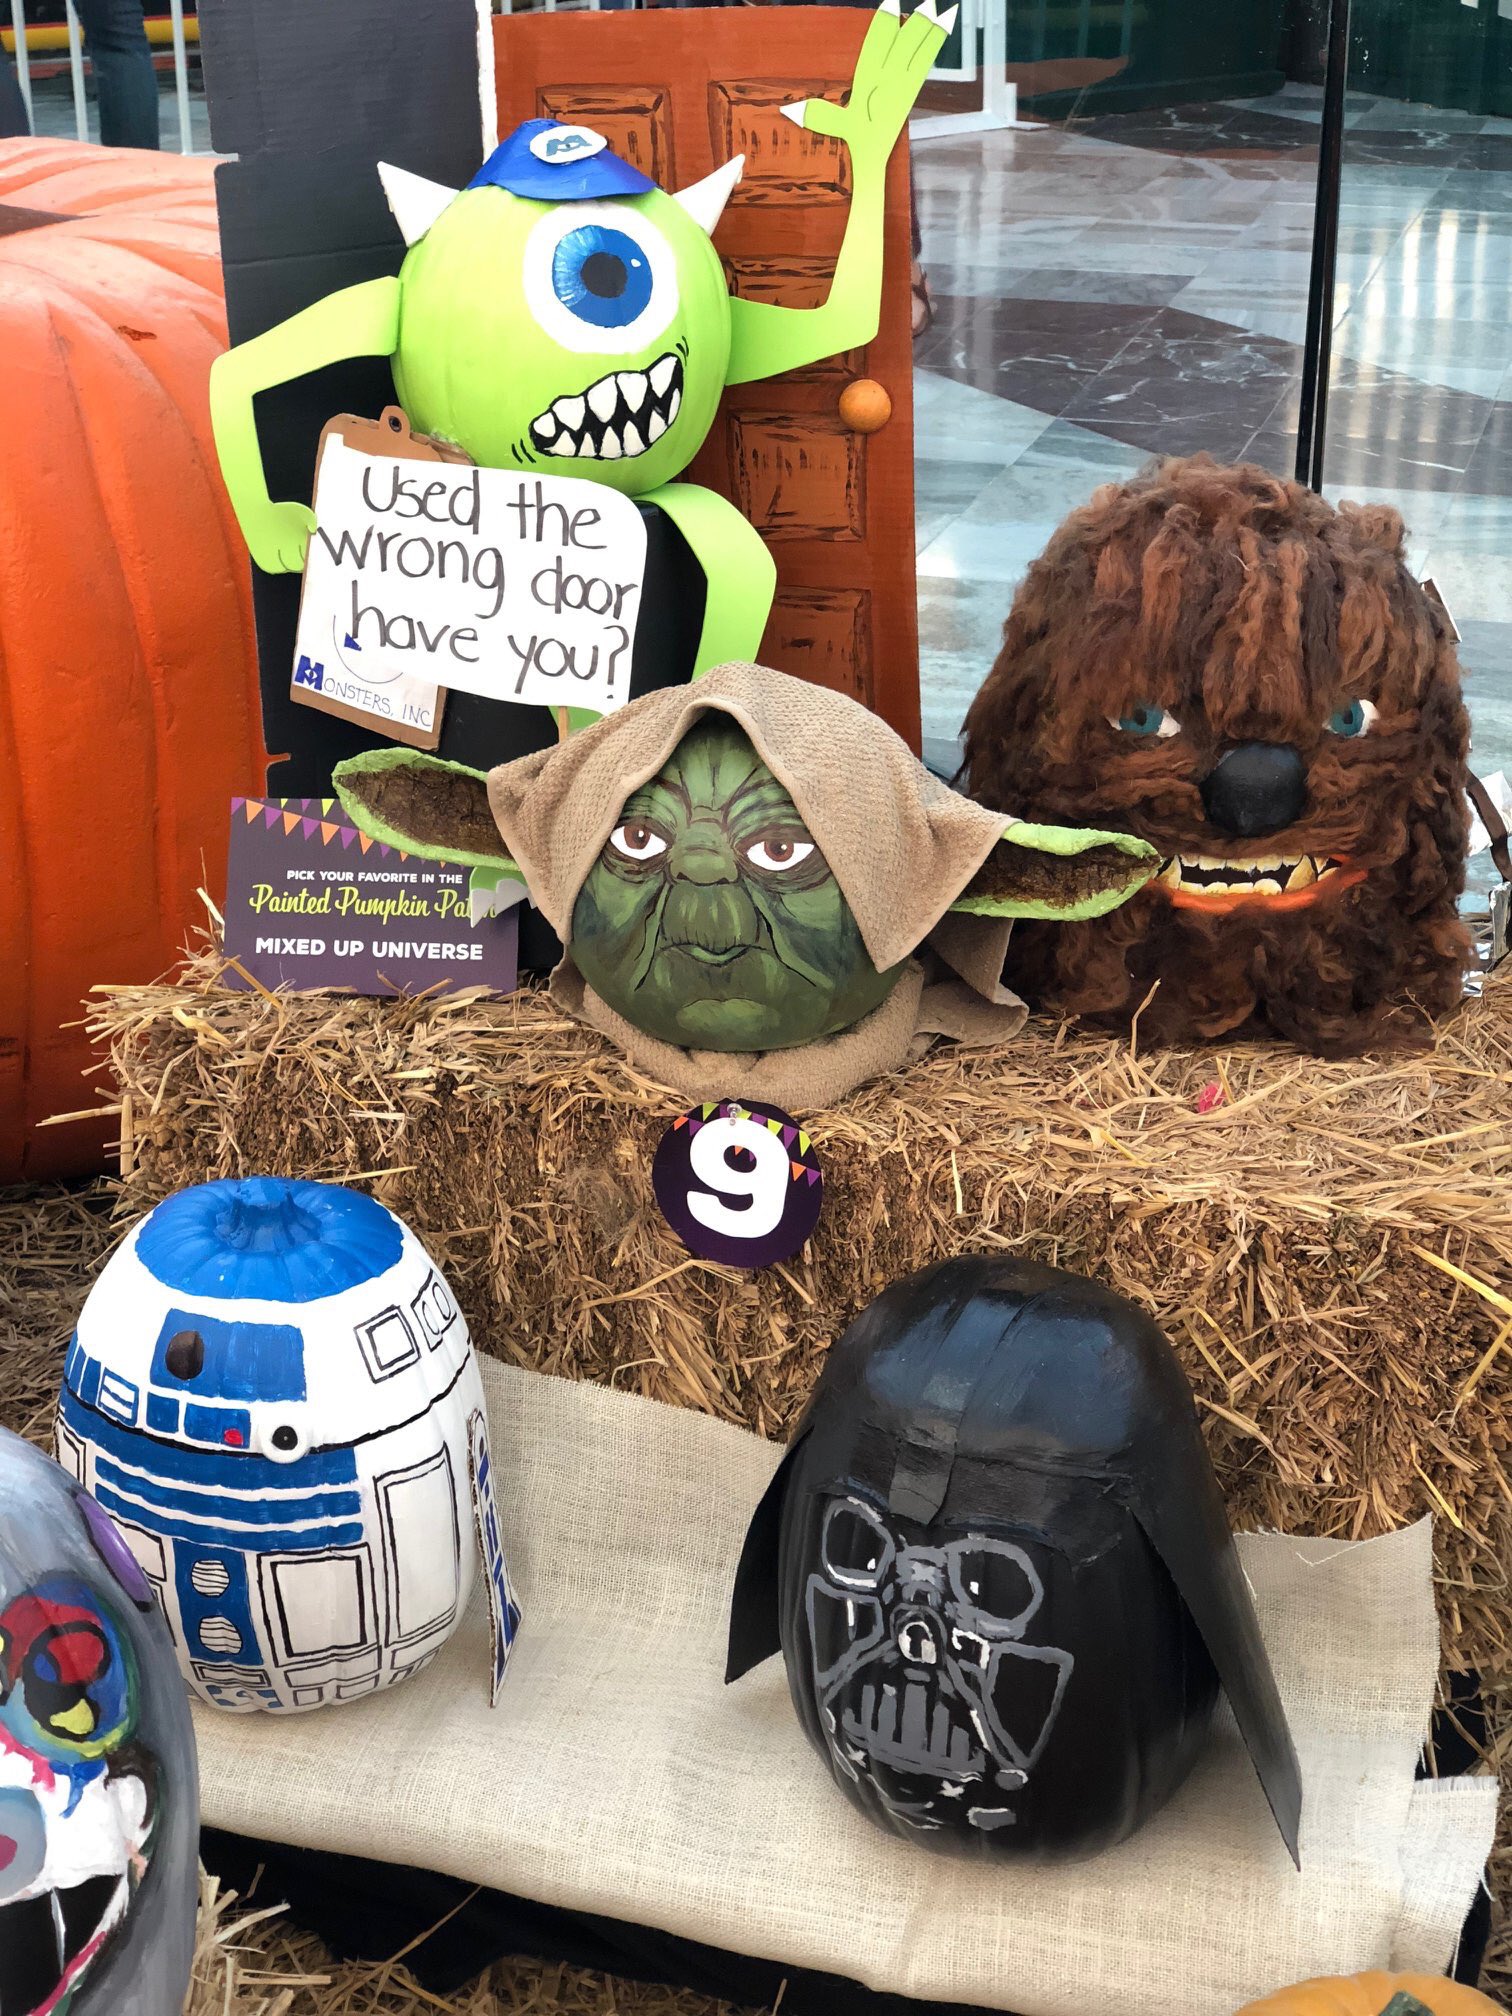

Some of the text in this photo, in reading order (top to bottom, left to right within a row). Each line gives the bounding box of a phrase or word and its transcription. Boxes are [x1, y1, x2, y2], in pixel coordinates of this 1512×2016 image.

[362, 465, 608, 549] Used the
[316, 524, 639, 620] wrong door
[351, 579, 630, 700] have you?
[294, 654, 433, 728] MONSTERS, INC
[248, 883, 332, 915] Painted
[334, 886, 431, 926] Pumpkin
[286, 869, 463, 884] PICK YOUR FAVORITE IN THE
[255, 937, 483, 961] MIXED UP UNIVERSE
[686, 1116, 790, 1239] 9
